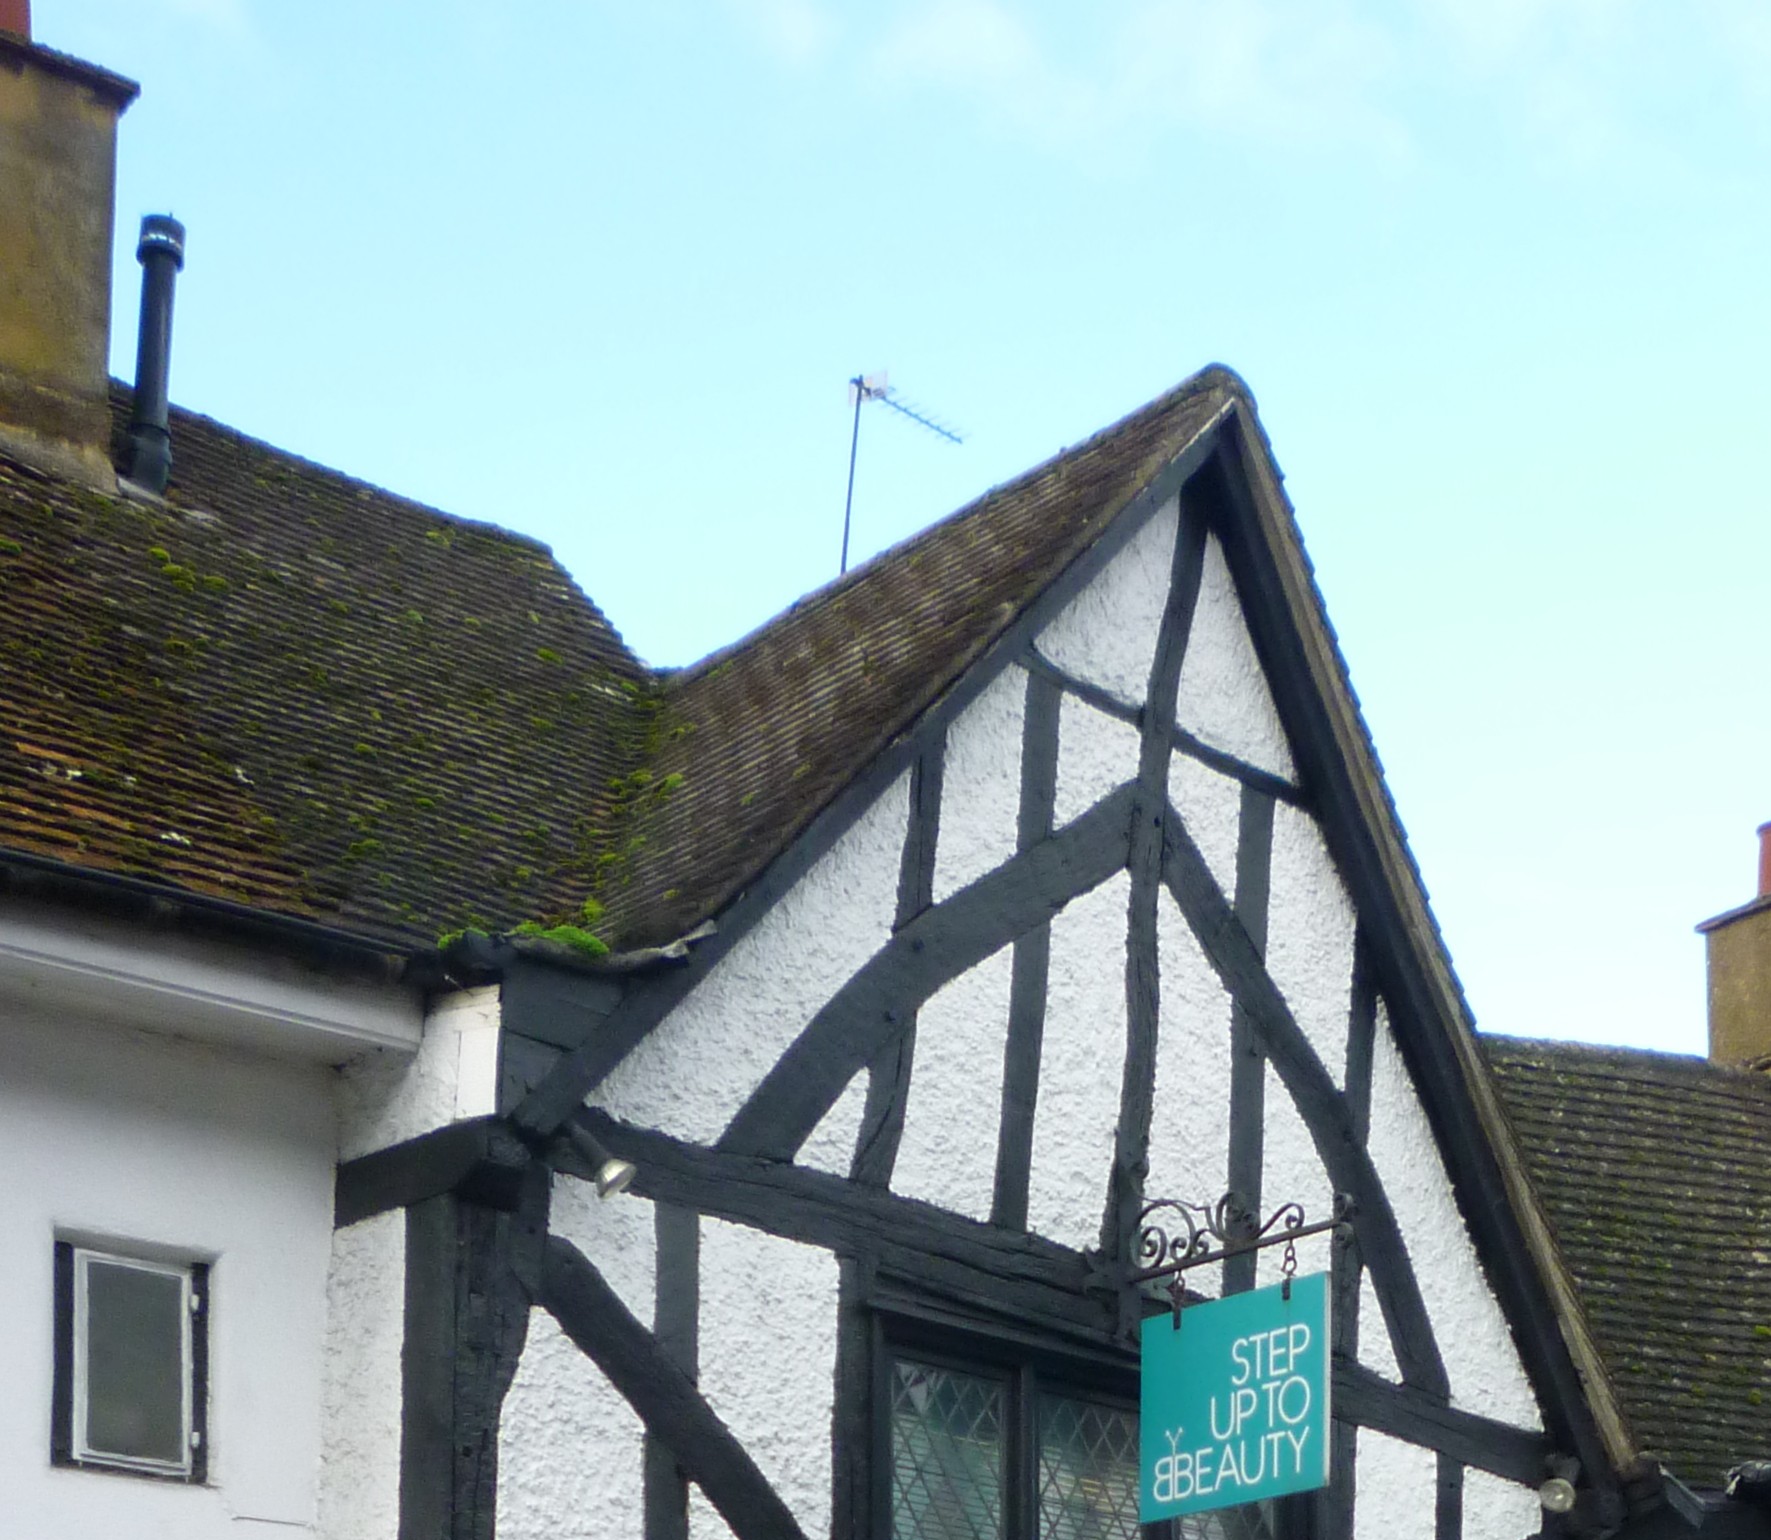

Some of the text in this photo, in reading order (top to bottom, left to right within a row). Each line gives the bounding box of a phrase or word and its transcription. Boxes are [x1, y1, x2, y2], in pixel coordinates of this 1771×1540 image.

[1231, 1323, 1310, 1385] STEP
[1210, 1375, 1310, 1440] UP TO
